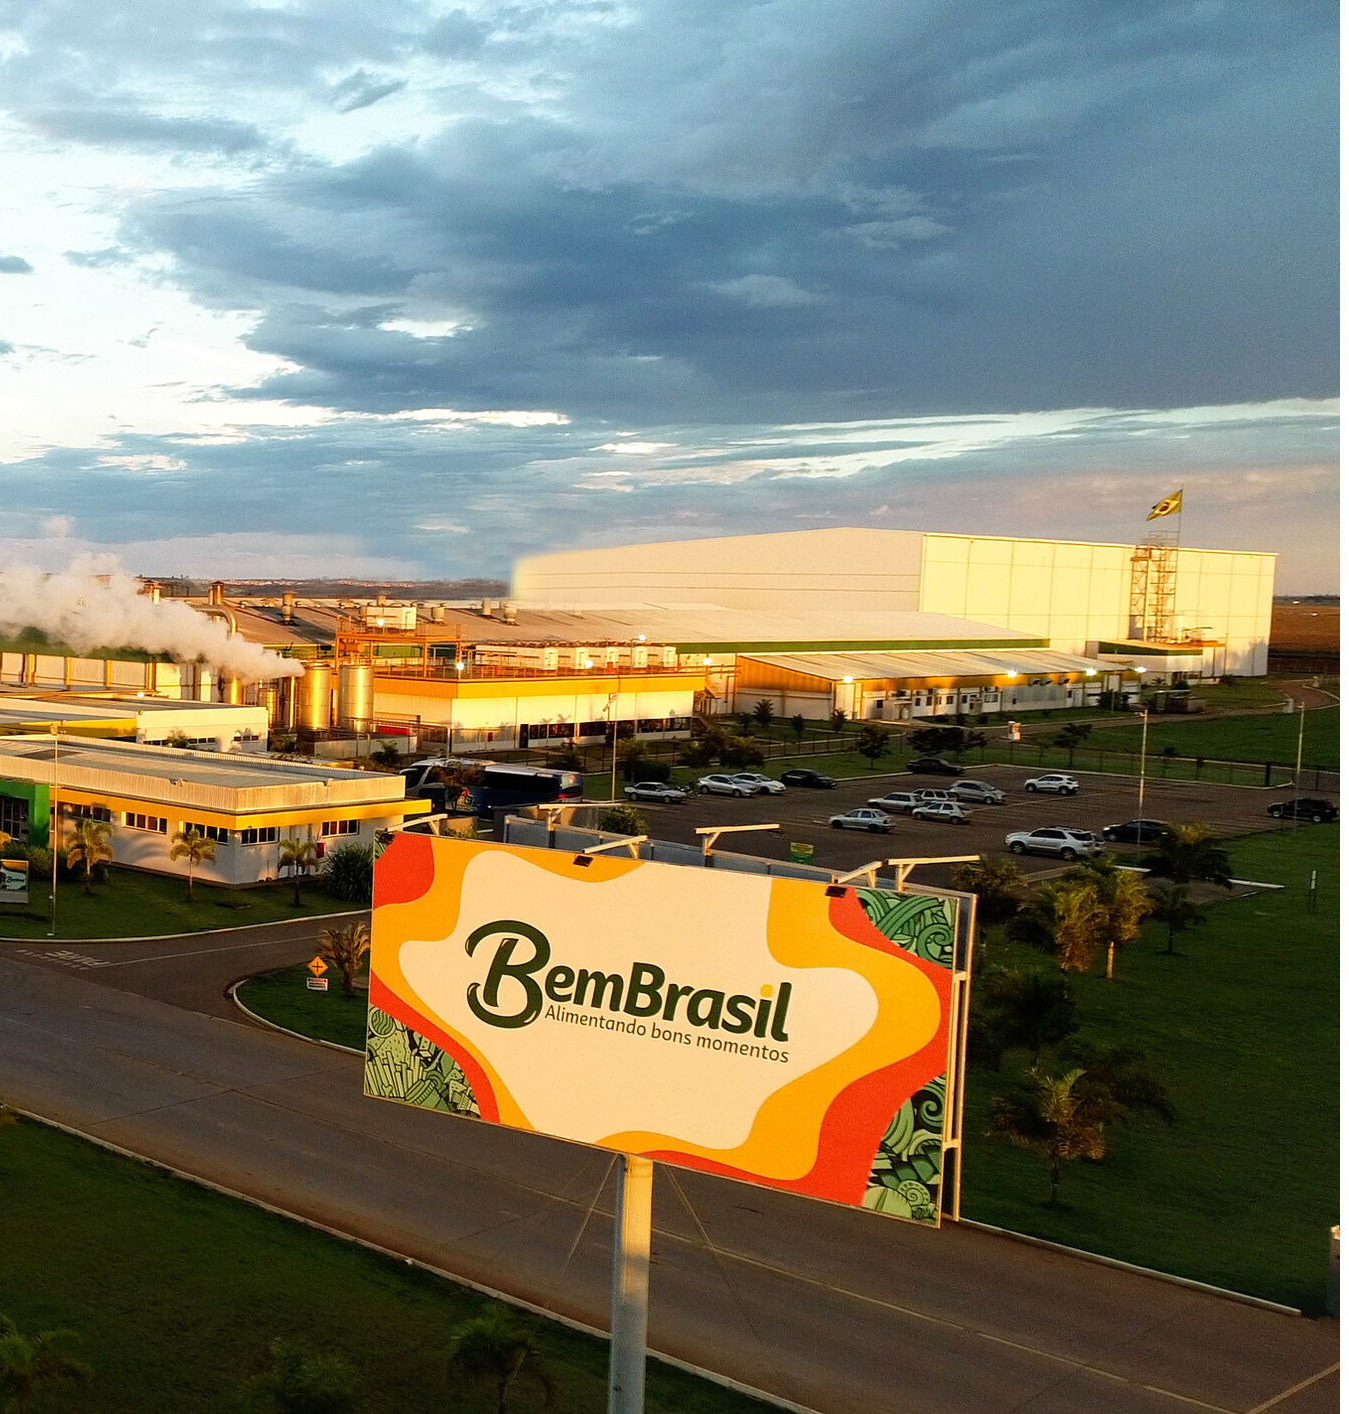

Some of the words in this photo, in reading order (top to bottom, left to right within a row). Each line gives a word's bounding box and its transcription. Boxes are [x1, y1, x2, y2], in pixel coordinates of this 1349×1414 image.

[465, 920, 793, 1042] BemBrasil
[545, 1004, 647, 1036] Alimentando
[651, 1026, 692, 1046] bons
[696, 1036, 790, 1063] momentos
